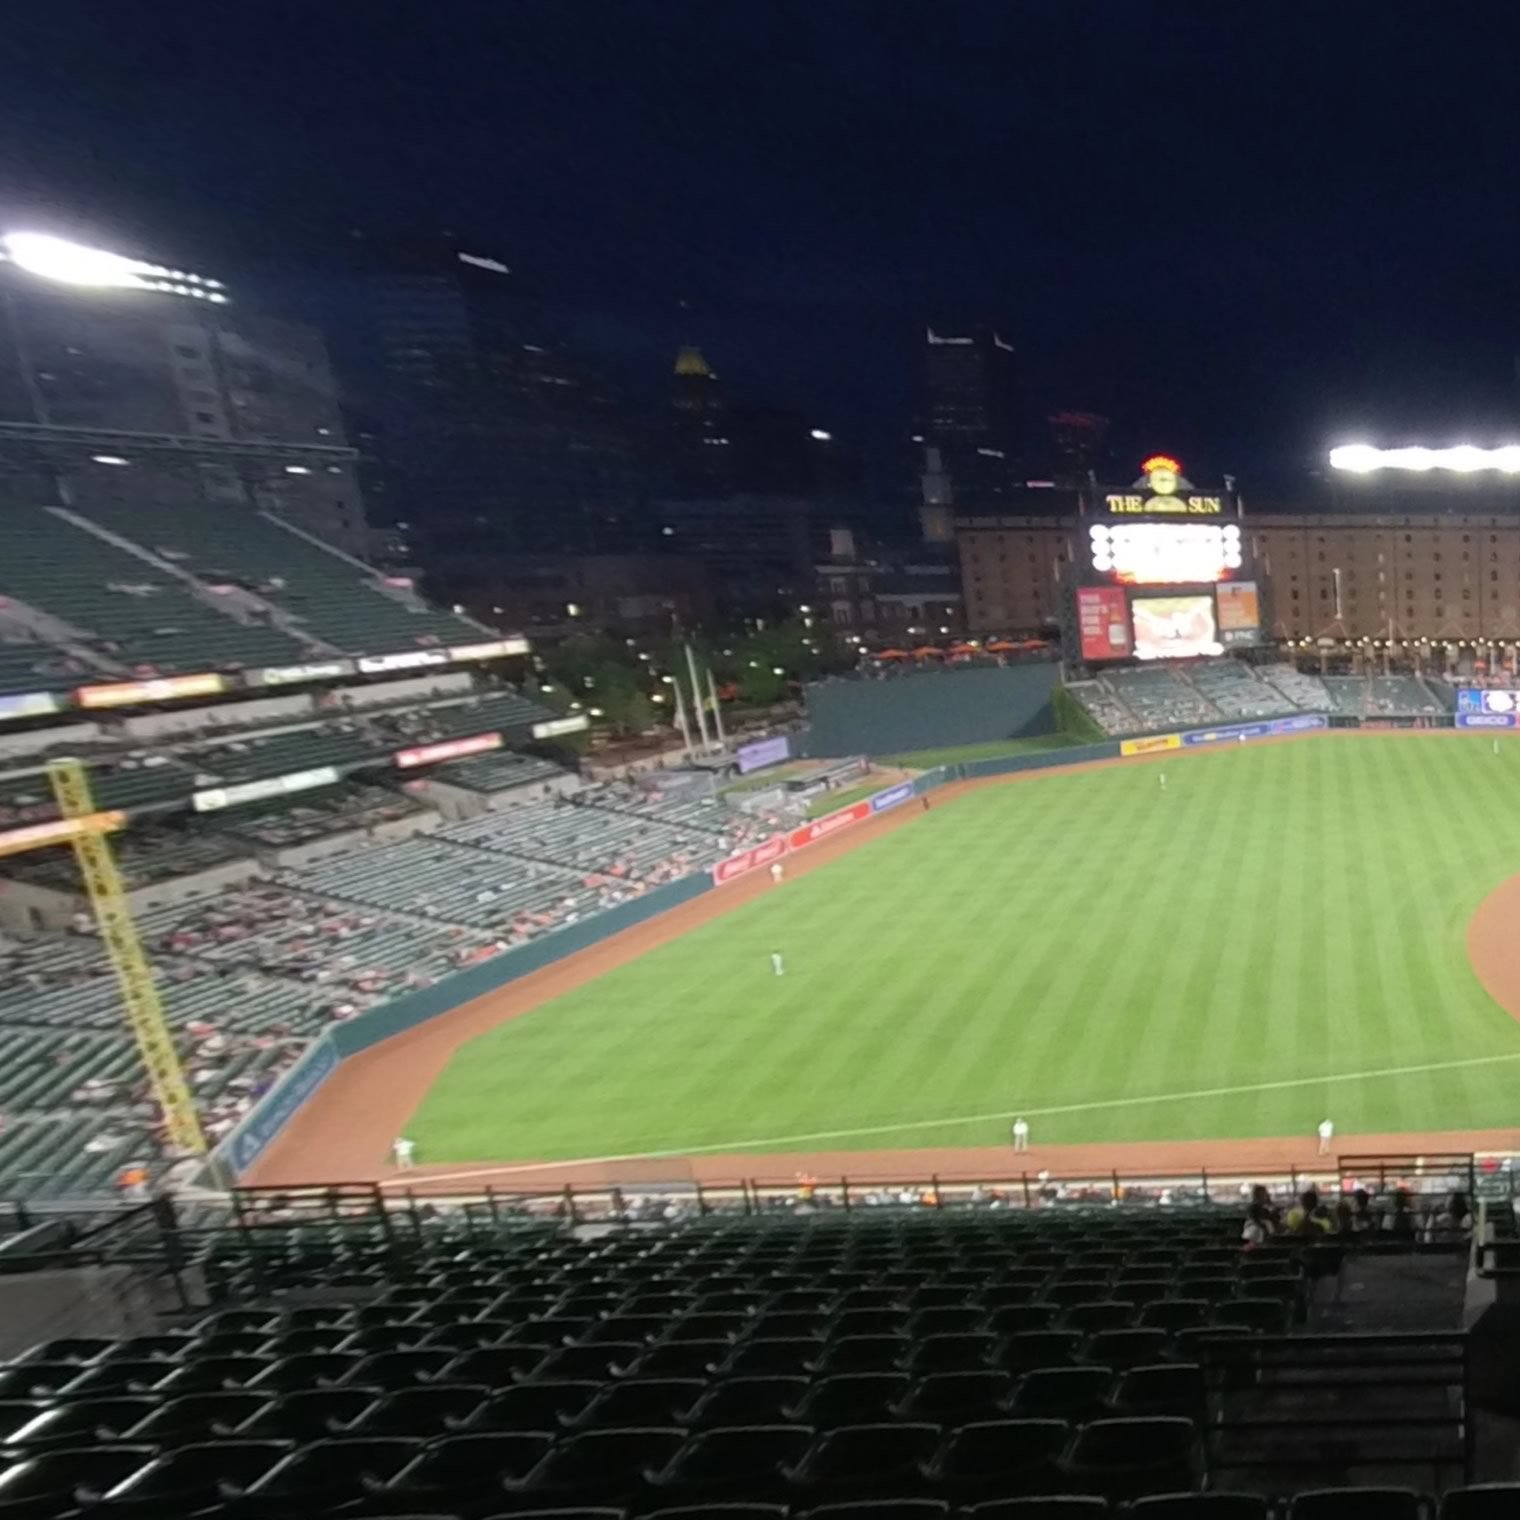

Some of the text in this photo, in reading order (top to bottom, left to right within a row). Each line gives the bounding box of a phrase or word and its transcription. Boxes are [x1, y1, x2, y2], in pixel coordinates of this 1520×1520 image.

[1106, 495, 1219, 513] THE SUN
[1466, 715, 1508, 725] GEICO
